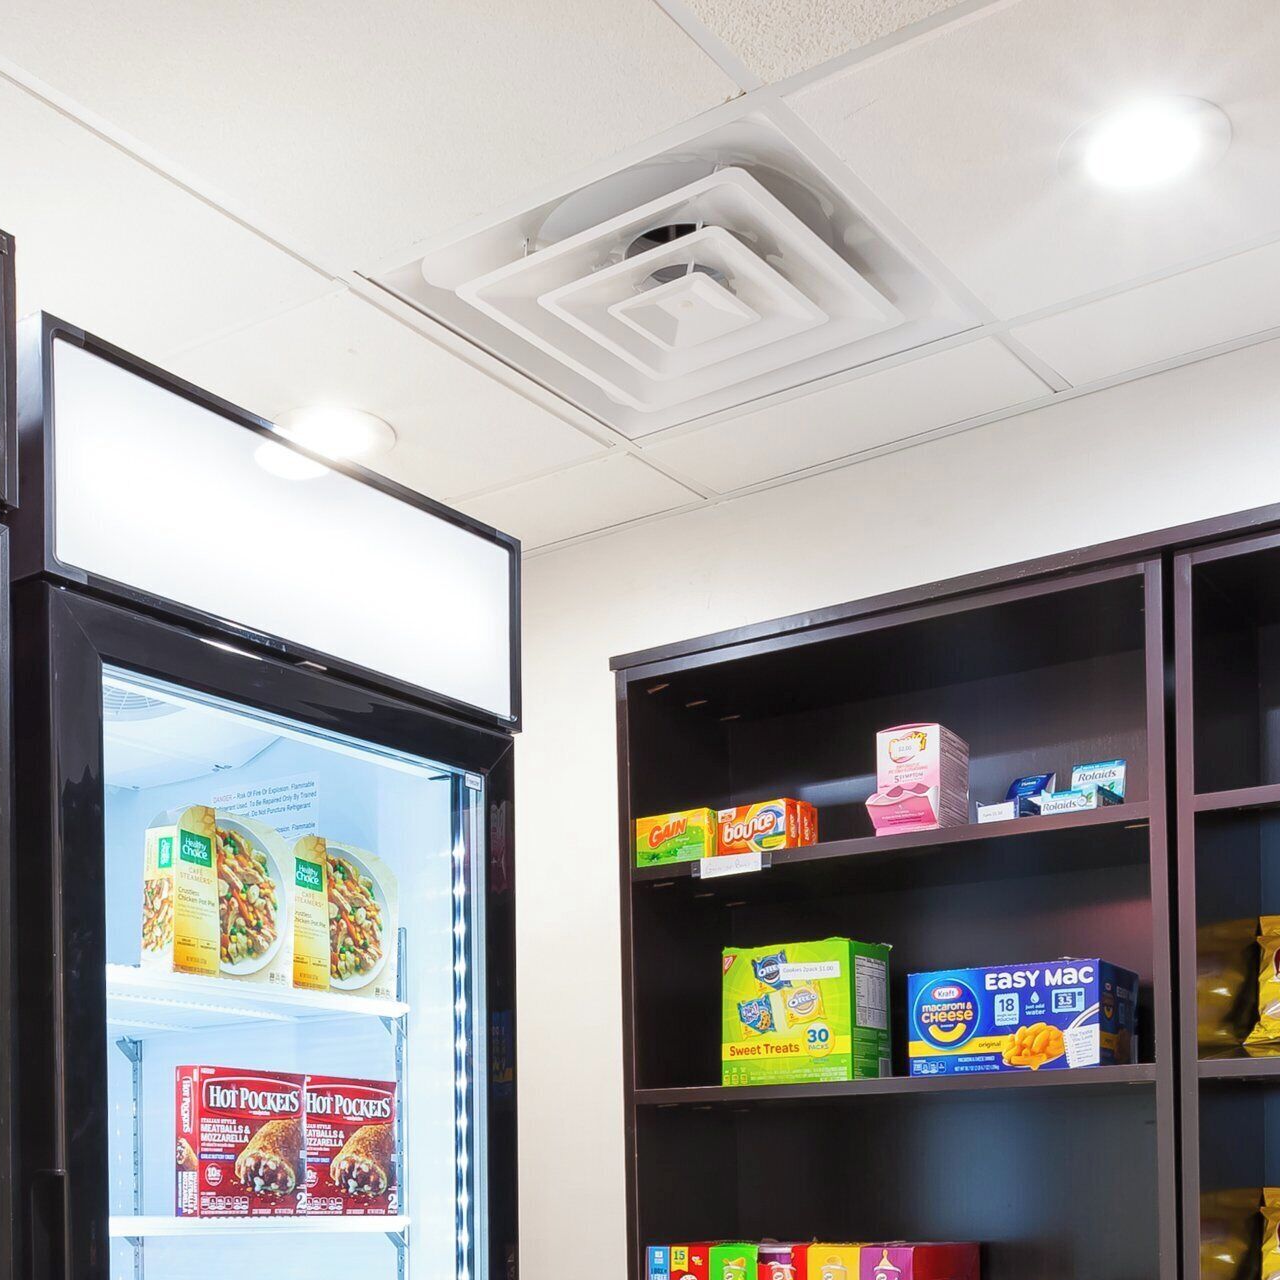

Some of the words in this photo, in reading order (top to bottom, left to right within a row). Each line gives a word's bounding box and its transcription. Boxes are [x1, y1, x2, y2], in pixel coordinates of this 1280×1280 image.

[1078, 769, 1117, 782] Rolaids
[1043, 800, 1077, 812] Rolaids
[649, 818, 687, 848] GAIN
[723, 813, 776, 843] bounce
[185, 838, 207, 851] Healthy
[183, 845, 208, 860] Choice
[299, 865, 318, 878] Healthy
[296, 872, 319, 885] Choice
[937, 990, 955, 998] Kraft
[1058, 996, 1072, 1005] 3.5
[922, 1003, 965, 1012] macaroni
[999, 999, 1014, 1012] 18
[807, 1029, 829, 1042] 30
[730, 1046, 761, 1056] Sweet
[764, 1043, 800, 1054] Treats
[978, 1040, 1001, 1049] original
[210, 1085, 238, 1108] HOT
[240, 1090, 299, 1113] POCKETS
[306, 1092, 332, 1114] HOT
[334, 1097, 390, 1117] POCKETS
[201, 1124, 243, 1134] MEATBALLS
[201, 1134, 249, 1143] MOZZARELLA
[674, 1250, 685, 1260] 15
